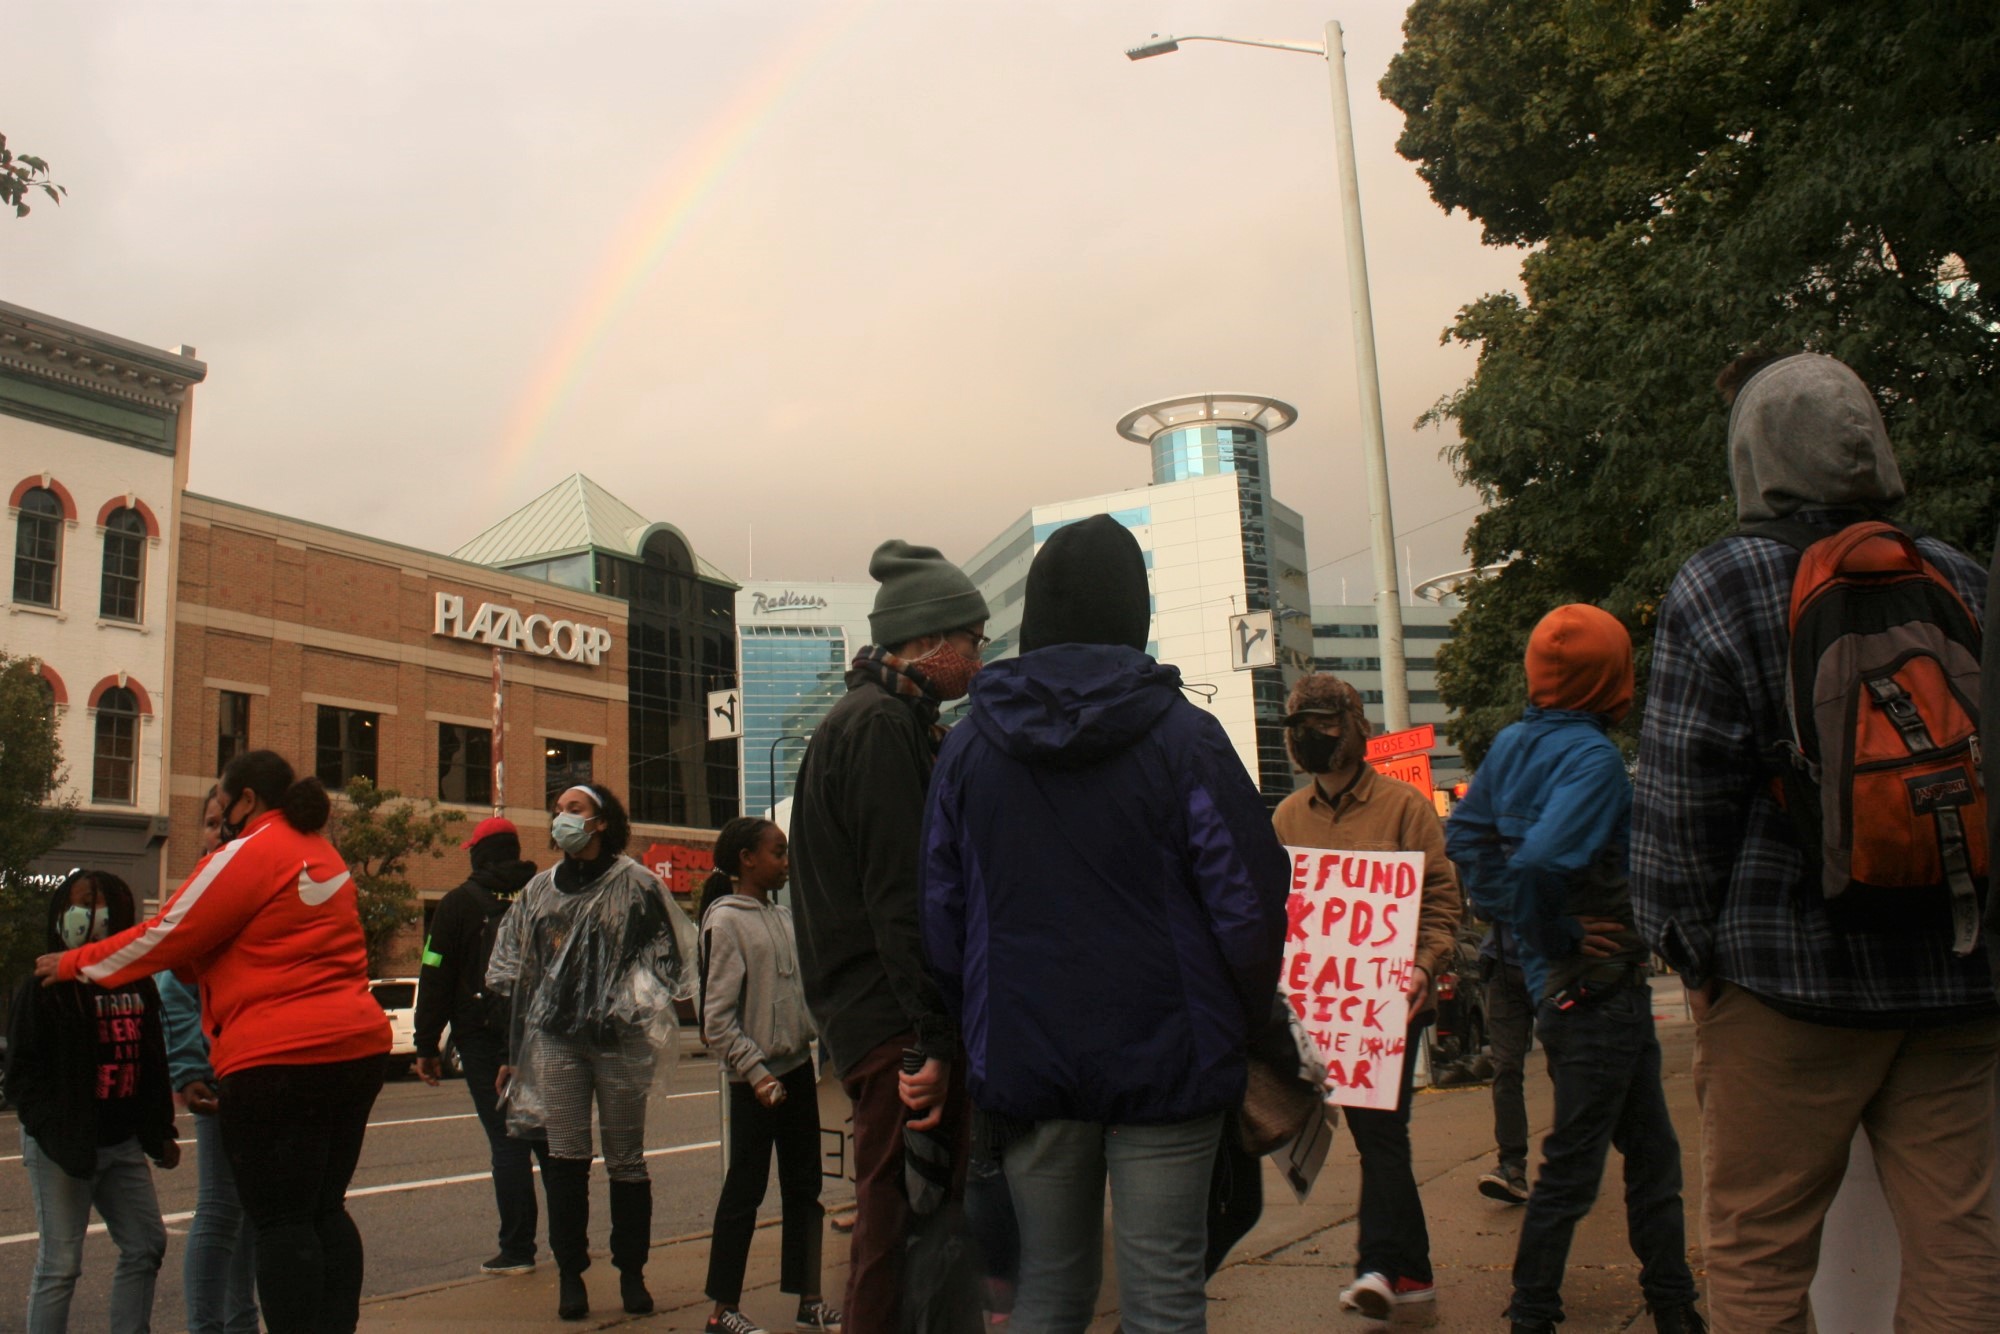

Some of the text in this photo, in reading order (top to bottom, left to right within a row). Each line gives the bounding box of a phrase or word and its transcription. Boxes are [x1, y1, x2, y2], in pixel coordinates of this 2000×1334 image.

[752, 589, 827, 615] Radisson
[434, 591, 612, 666] PLAZACORP
[1374, 733, 1421, 755] ROSE ST
[1381, 766, 1422, 783] OUR
[672, 844, 714, 871] Sou
[1292, 853, 1416, 898] EFUND
[1279, 952, 1414, 995] EAL THE
[1326, 1059, 1374, 1089] AR
